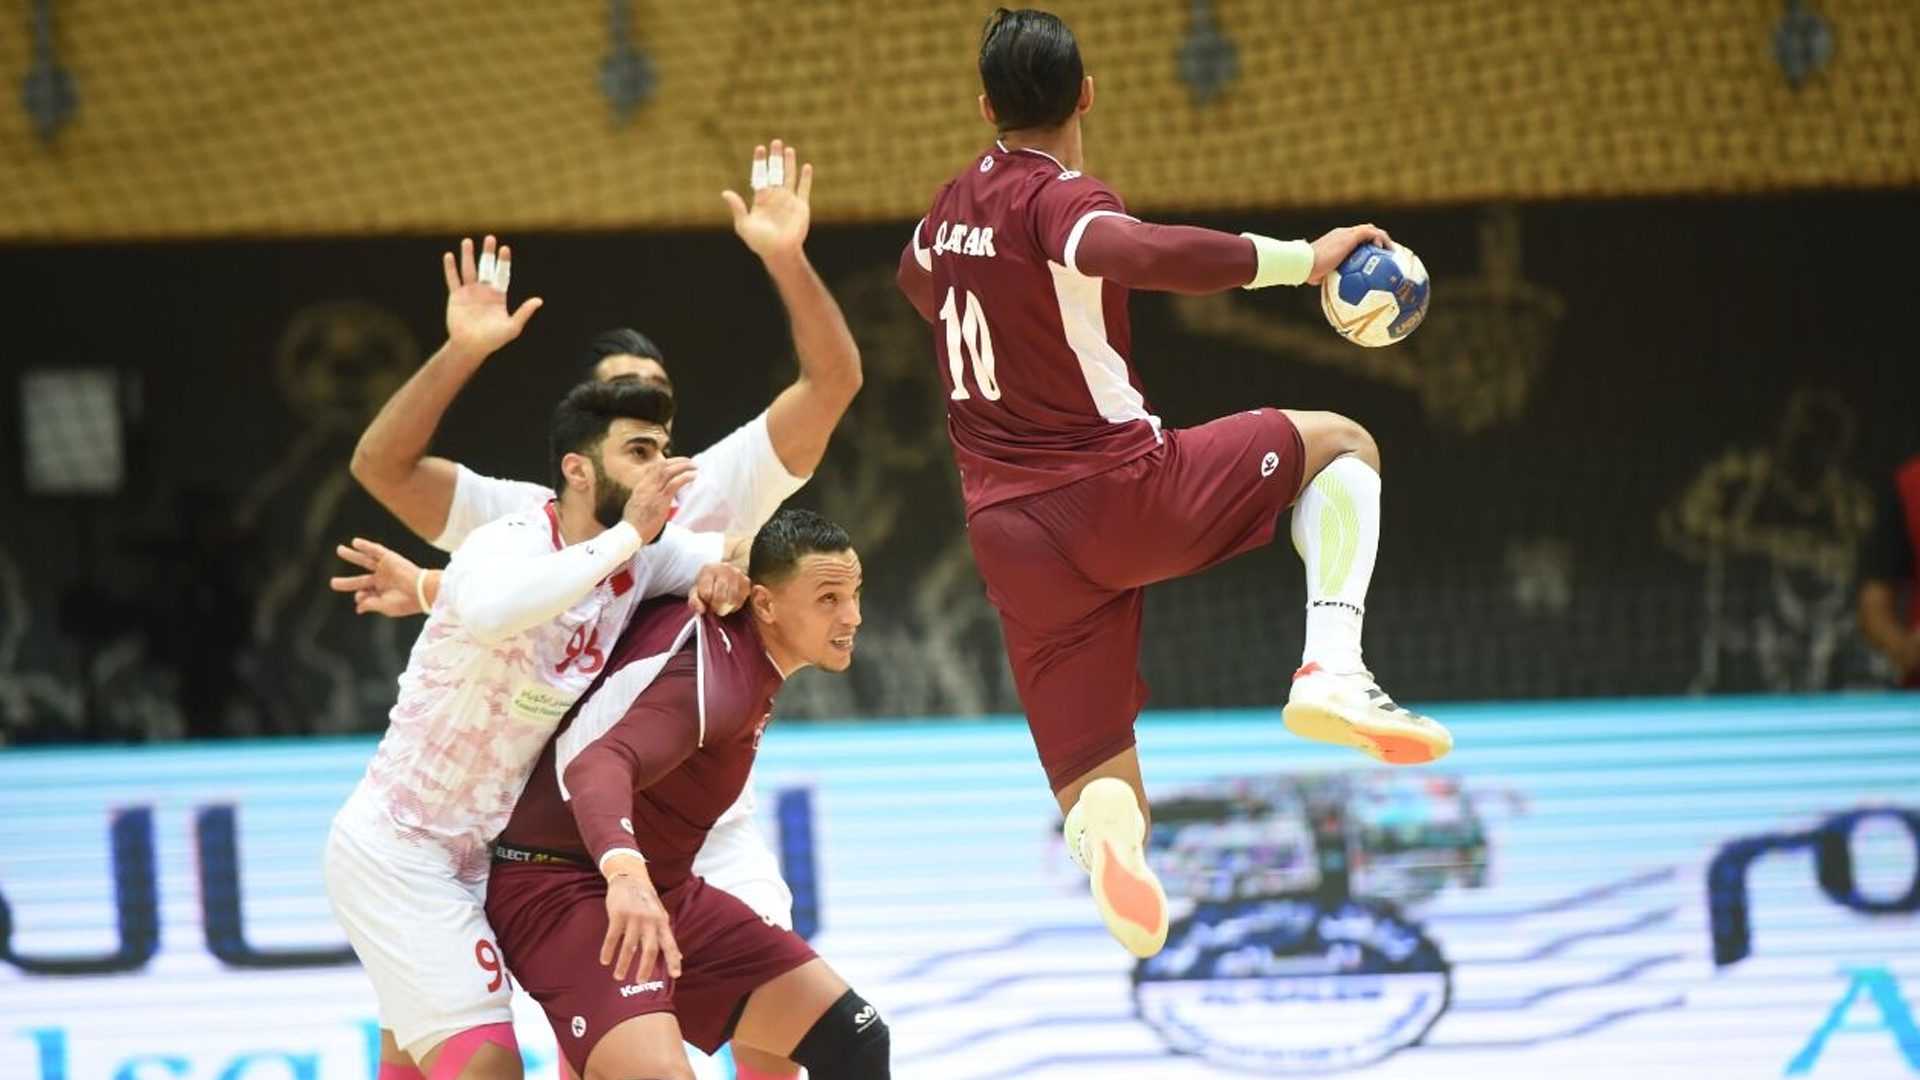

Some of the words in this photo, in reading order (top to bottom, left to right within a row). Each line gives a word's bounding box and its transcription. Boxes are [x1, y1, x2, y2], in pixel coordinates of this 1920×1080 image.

[933, 221, 996, 257] QATAR
[939, 286, 1001, 401] 10
[475, 938, 513, 993] 9
